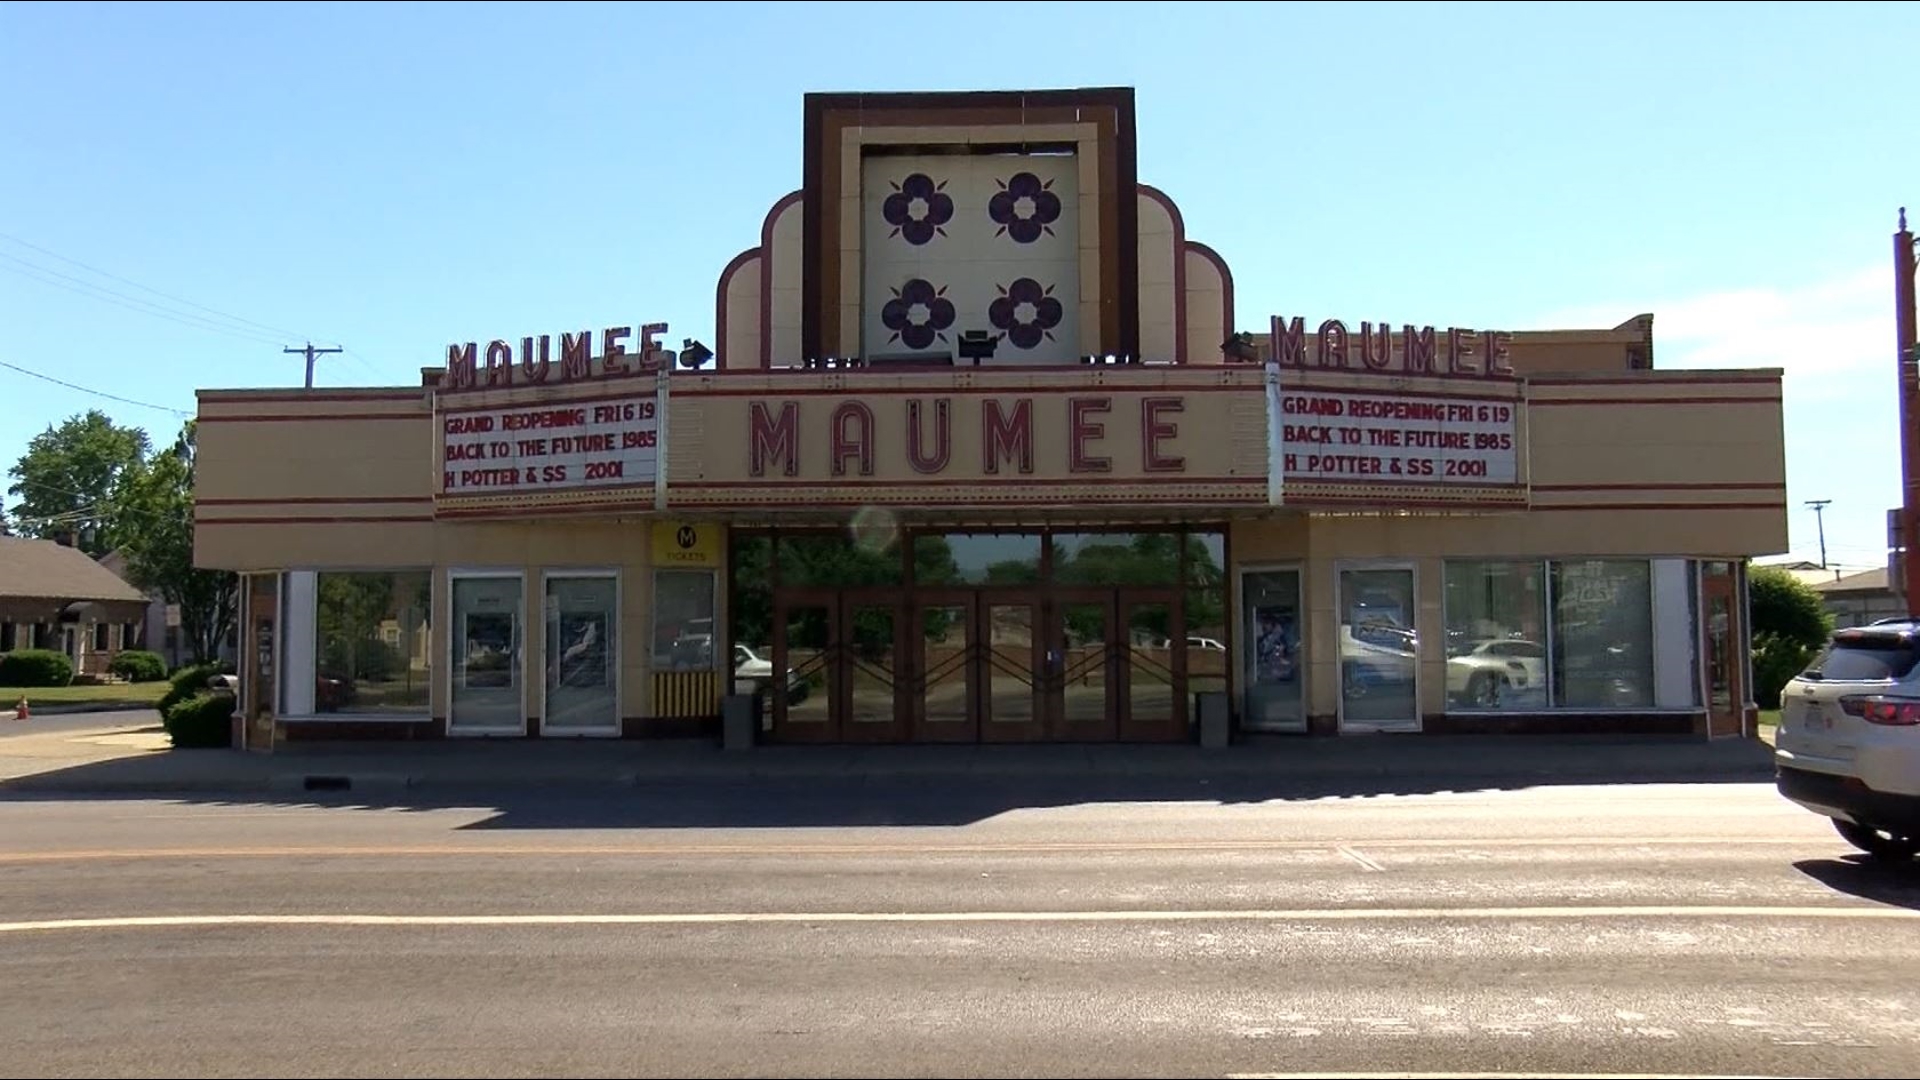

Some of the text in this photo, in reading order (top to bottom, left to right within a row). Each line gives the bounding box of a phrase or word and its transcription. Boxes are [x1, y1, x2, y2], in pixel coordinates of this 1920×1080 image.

[446, 322, 668, 388] MAUMEE
[1270, 315, 1515, 377] MAUMEE
[447, 416, 494, 434] GRAND
[502, 408, 585, 431] REOPENING
[1283, 397, 1510, 423] GRAND REOPENING FRI 6 19
[446, 430, 657, 461] BACK TO THE FUTURE 1985
[748, 396, 1187, 477] MAUMEE
[1283, 425, 1512, 450] BACK TO THE FUTURE 1985
[445, 460, 624, 488] H POTTER & SS 2001
[1284, 453, 1487, 477] H POTTER & SS 2001
[667, 552, 706, 562] TICKETS
